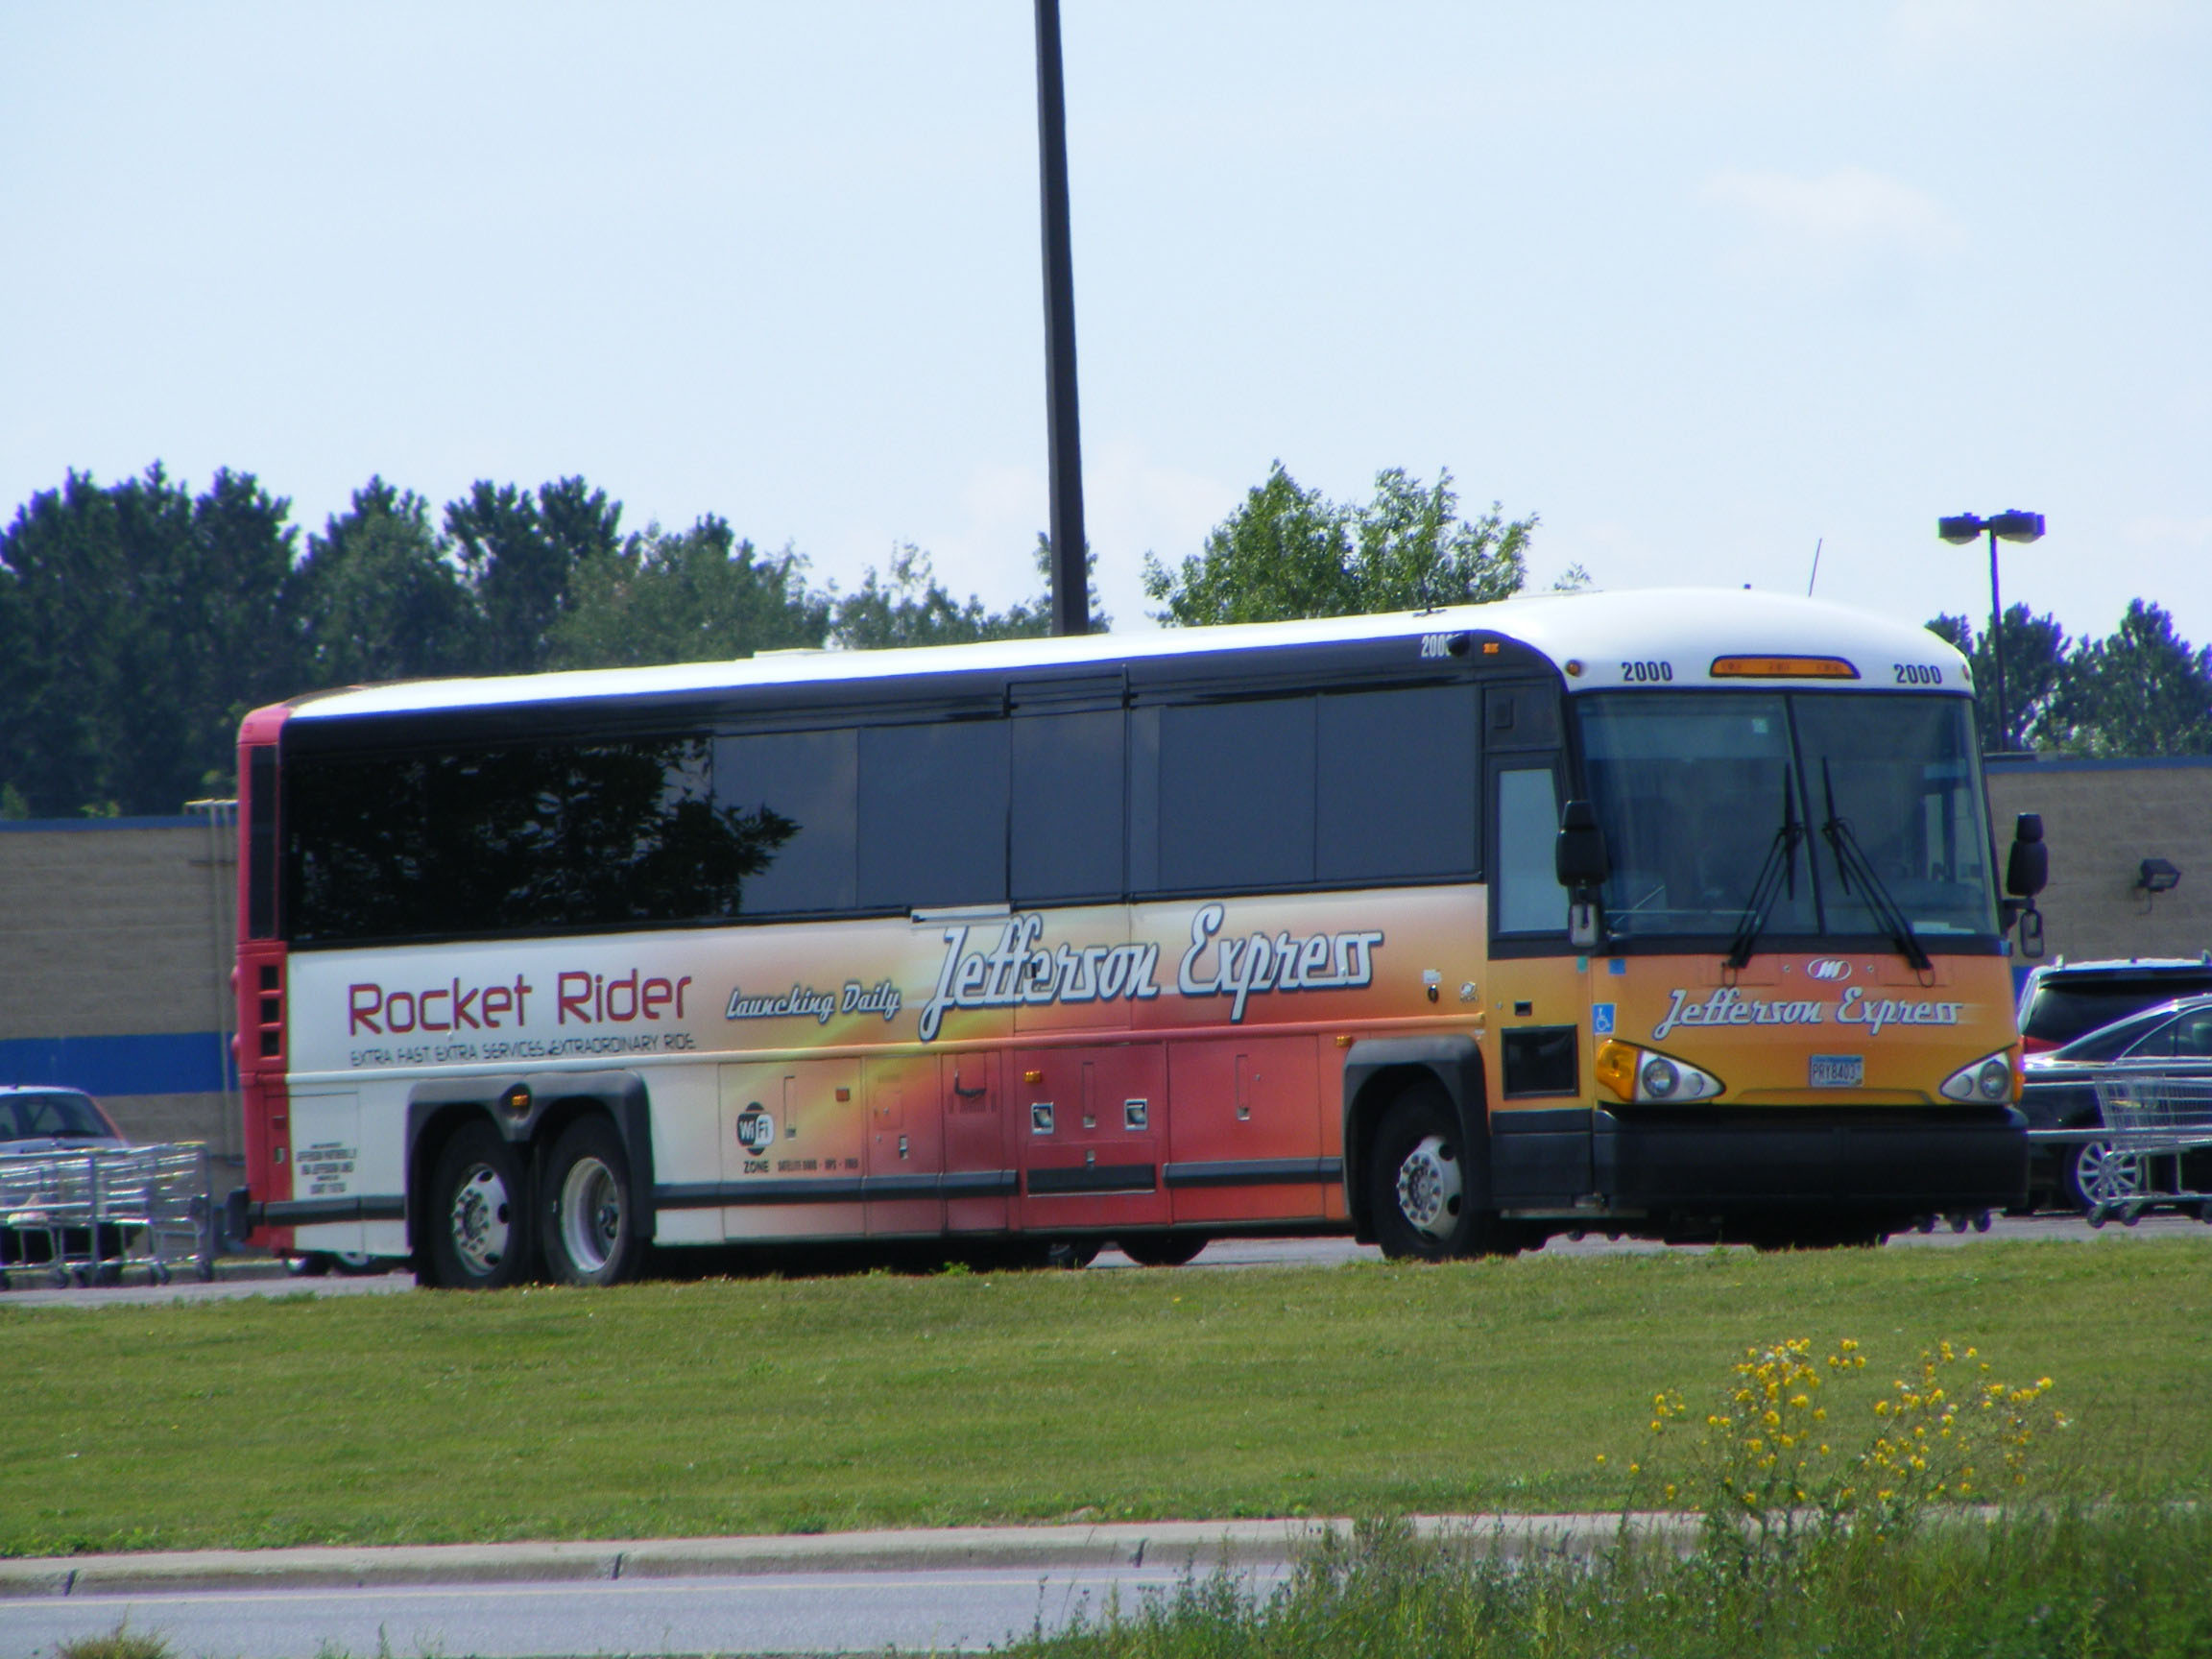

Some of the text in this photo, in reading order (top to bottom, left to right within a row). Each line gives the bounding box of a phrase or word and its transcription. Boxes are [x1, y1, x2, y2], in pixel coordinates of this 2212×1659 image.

[1620, 661, 1673, 682] 2000
[1893, 663, 1943, 685] 2000
[918, 901, 1383, 1043] Jefferson Express
[349, 968, 692, 1037] Rocket Rider
[724, 978, 902, 1025] Launching Daily
[1651, 985, 1964, 1041] Jefferson Express
[350, 1047, 393, 1068] EXTRA
[397, 1046, 431, 1065] FAST
[435, 1044, 478, 1063] EXTRA
[662, 1032, 696, 1050] RIDE
[738, 1118, 770, 1141] WiFi
[743, 1159, 770, 1174] ZONE
